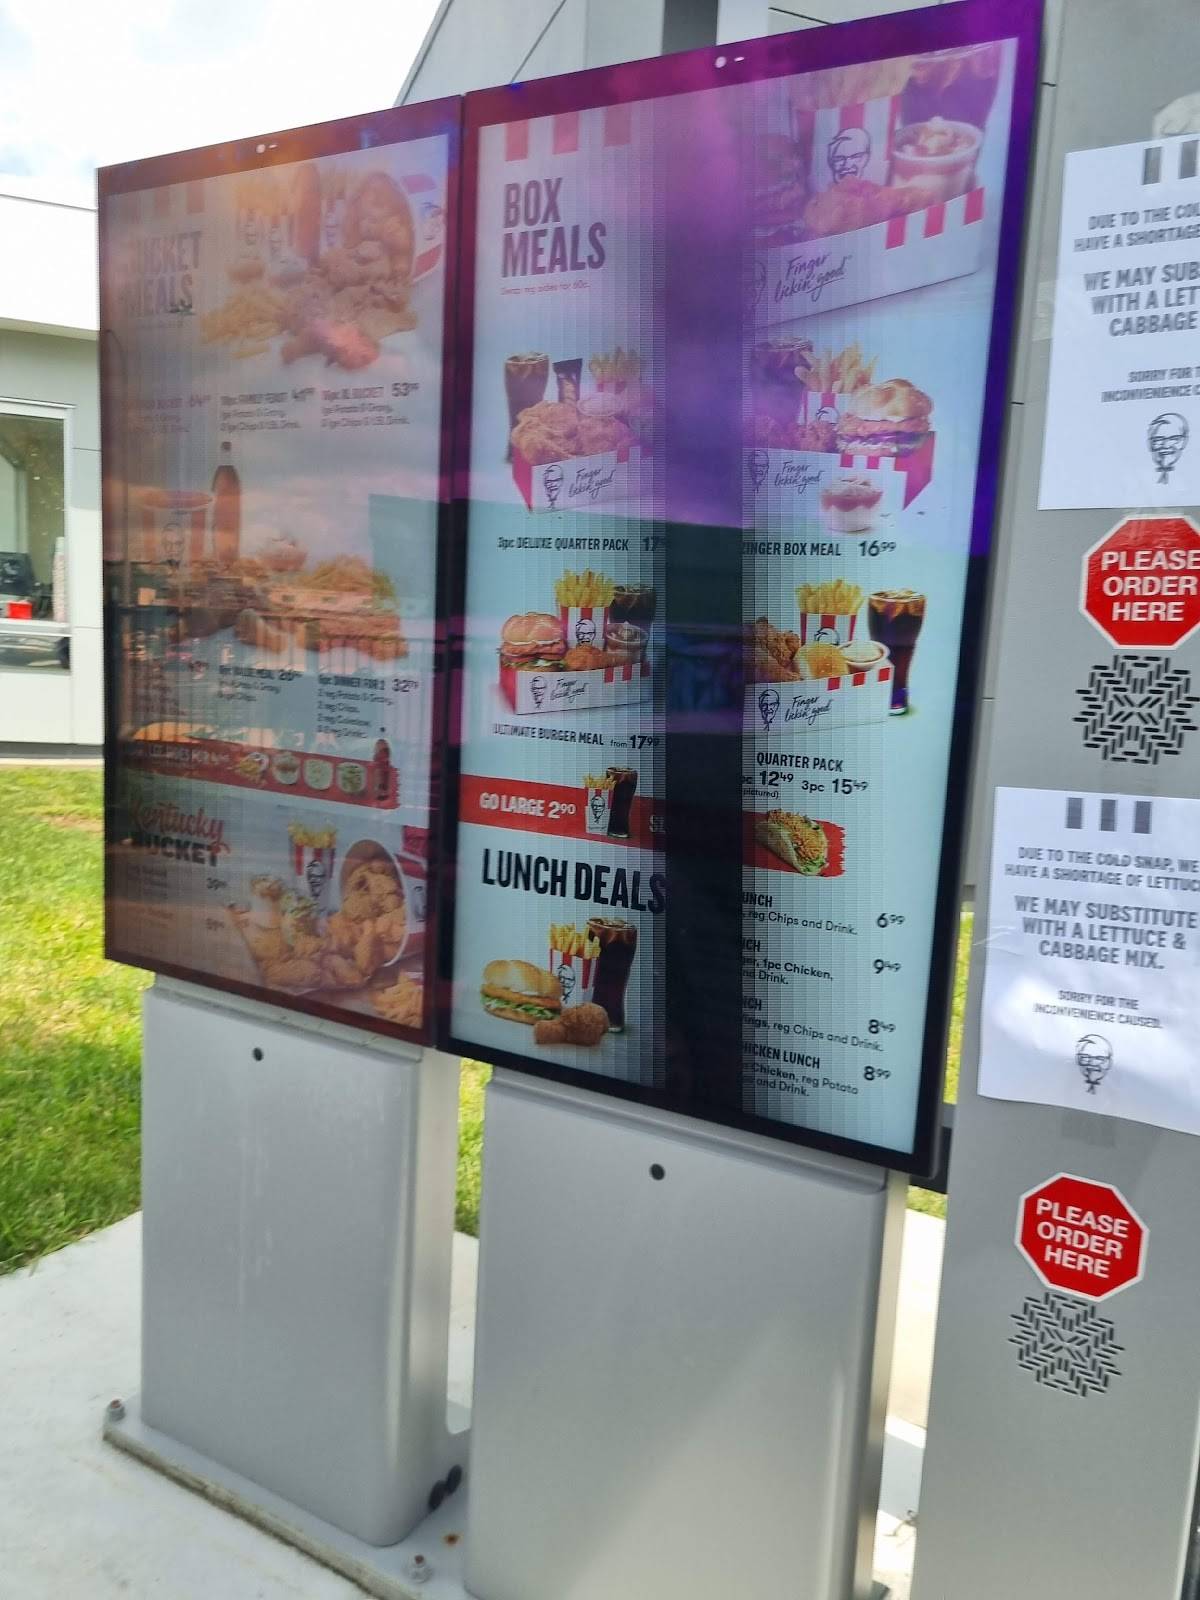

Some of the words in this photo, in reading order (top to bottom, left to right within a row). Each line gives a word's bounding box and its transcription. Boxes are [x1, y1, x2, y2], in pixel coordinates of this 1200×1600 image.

[504, 177, 563, 229] BOX
[1120, 212, 1140, 227] TO
[1143, 207, 1171, 223] THE
[501, 222, 606, 279] MEALS
[1113, 233, 1123, 248] A
[1083, 271, 1112, 291] WE
[1115, 266, 1157, 288] MAY
[1091, 292, 1140, 315] WITH
[1145, 290, 1159, 309] A
[1109, 311, 1198, 336] CABBAGE
[517, 537, 552, 549] DELUXE
[555, 537, 600, 551] QUARTER
[602, 538, 629, 551] PACK
[784, 542, 807, 556] BOX
[810, 542, 842, 556] MEAL
[1101, 550, 1200, 571] PLEASE
[1103, 575, 1198, 597] ORDER
[1112, 601, 1185, 622] HERE
[494, 722, 536, 738] ULTIMATE
[538, 727, 576, 743] BURGER
[578, 732, 604, 746] MEAL
[610, 739, 627, 748] from
[756, 752, 809, 769] QUARTER
[813, 758, 843, 772] PACK
[801, 780, 825, 793] 3pc
[480, 792, 499, 810] GO
[501, 794, 545, 816] LARGE
[1018, 846, 1044, 861] DUE
[1047, 848, 1064, 862] TO
[1067, 850, 1093, 864] THE
[1096, 853, 1132, 867] COLD
[1178, 859, 1199, 873] WE
[482, 848, 568, 898] LUNCH
[574, 862, 667, 914] DEALS
[1004, 863, 1038, 878] HAVE
[1040, 866, 1049, 879] A
[1052, 867, 1123, 885] SHORTAGE
[1126, 874, 1144, 887] OF
[1014, 895, 1039, 913] WE
[1044, 898, 1081, 917] MAY
[1085, 902, 1199, 929] SUBSTITUTE
[768, 912, 799, 925] Chips
[802, 919, 822, 929] and
[825, 921, 858, 935] Drink.
[1022, 917, 1067, 938] WITH
[1071, 922, 1085, 939] A
[1088, 923, 1168, 948] LETTUCE
[1172, 932, 1186, 950] &
[1039, 940, 1120, 964] CABBAGE
[1125, 949, 1165, 969] MIX.
[758, 971, 789, 985] Drink.
[763, 959, 782, 971] 1pc
[784, 962, 834, 981] Chicken,
[1033, 1003, 1115, 1023] INCONVENIENCE
[1095, 994, 1116, 1006] FOR
[1118, 997, 1139, 1010] THE
[773, 1022, 790, 1034] reg
[793, 1024, 825, 1040] Chips
[827, 1033, 848, 1044] and
[783, 1050, 821, 1070] LUNCH
[757, 1079, 776, 1089] and
[779, 1080, 810, 1097] Drink.
[802, 1075, 819, 1088] reg
[822, 1078, 859, 1094] Potato
[1036, 1197, 1129, 1238] PLEASE
[1037, 1221, 1123, 1260] ORDER
[1044, 1244, 1111, 1279] HERE
